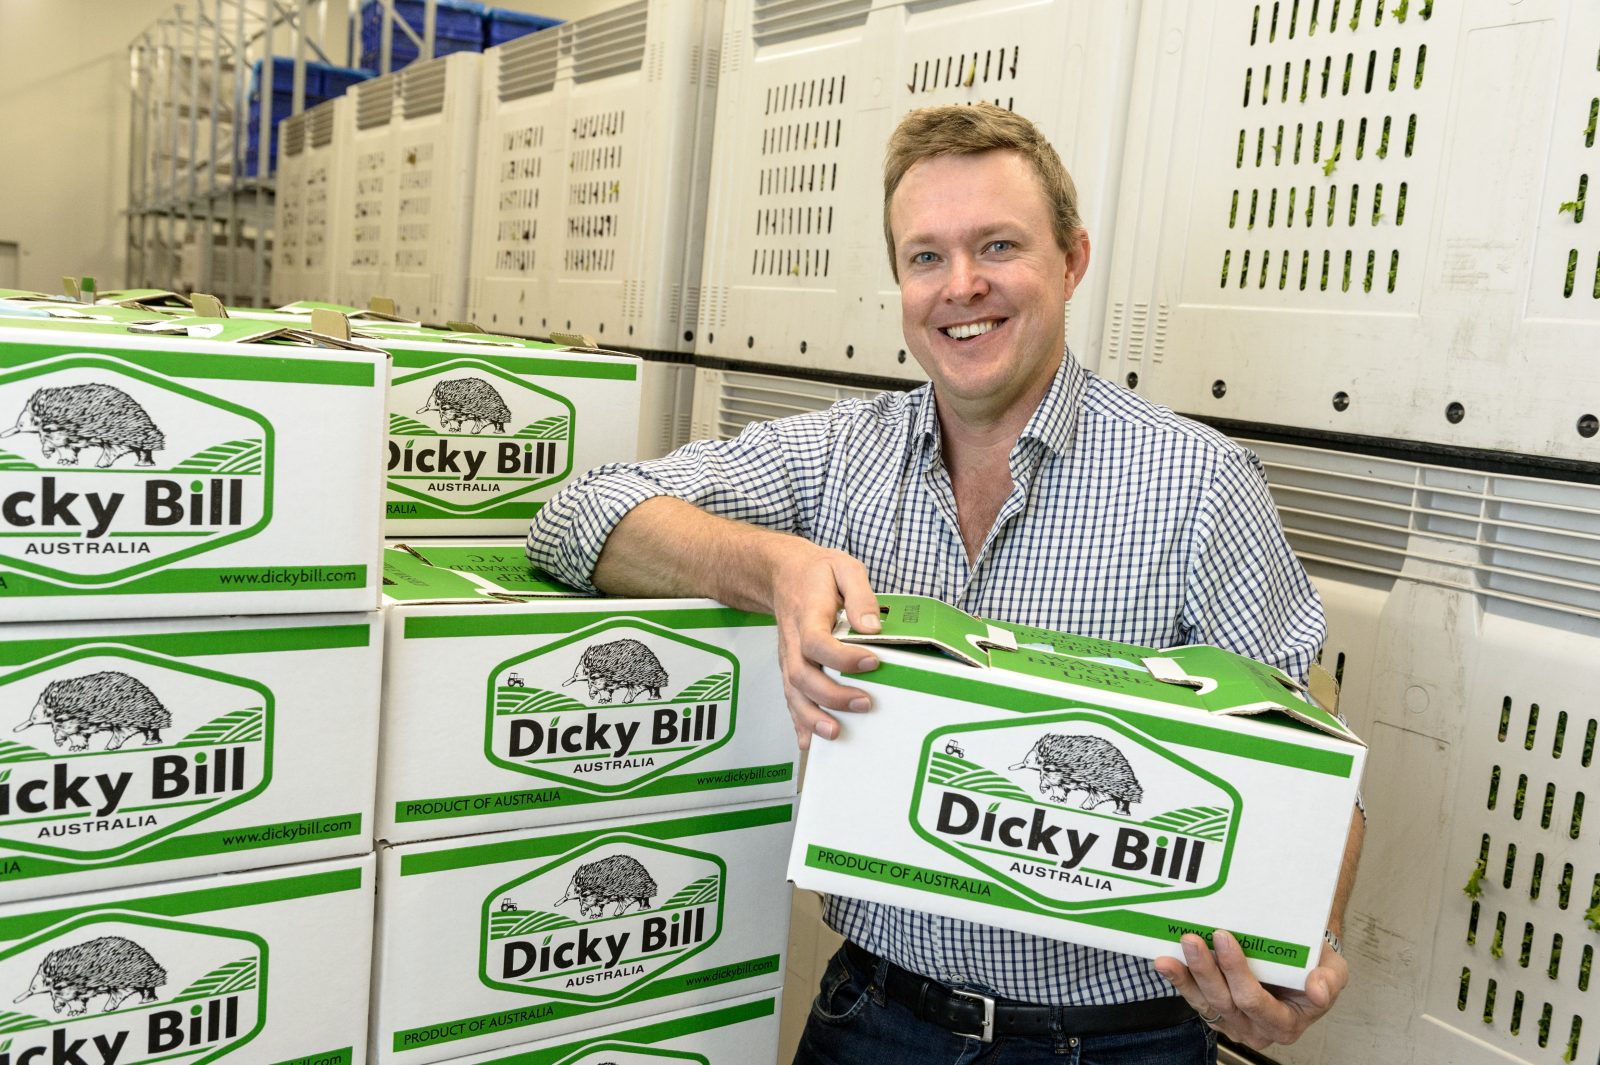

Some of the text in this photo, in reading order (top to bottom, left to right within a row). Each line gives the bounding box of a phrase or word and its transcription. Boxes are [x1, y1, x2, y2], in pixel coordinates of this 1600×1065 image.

[497, 442, 556, 474] Bill
[427, 482, 500, 492] AUSTRALIA
[1, 477, 242, 538] cky Bill
[386, 504, 417, 514] RALIA
[25, 542, 151, 555] AUSTRALIA
[219, 569, 356, 587] www.dickybill.com
[509, 704, 717, 758] Dicky Bill
[573, 756, 655, 774] AUSTRALIA
[697, 767, 787, 786] www.dickybill.com
[0, 746, 245, 817] icky Bill
[405, 791, 561, 817] PRODUCT OF AUSTRALIA
[37, 814, 158, 839] AUSTRALIA
[222, 819, 352, 847] www.dickybill.com
[936, 791, 1205, 883] Dicky Bill
[817, 850, 992, 897] PRODUCT OF AUSTRALIA
[1009, 861, 1113, 891] AUSTRALIA
[502, 908, 704, 979] Dicky Bill
[565, 964, 645, 988] AUSTRALIA
[686, 960, 773, 987] www.dickybill.com
[148, 996, 238, 1054] Bill
[404, 1005, 554, 1046] PRODUCT OF AUSTRALIA
